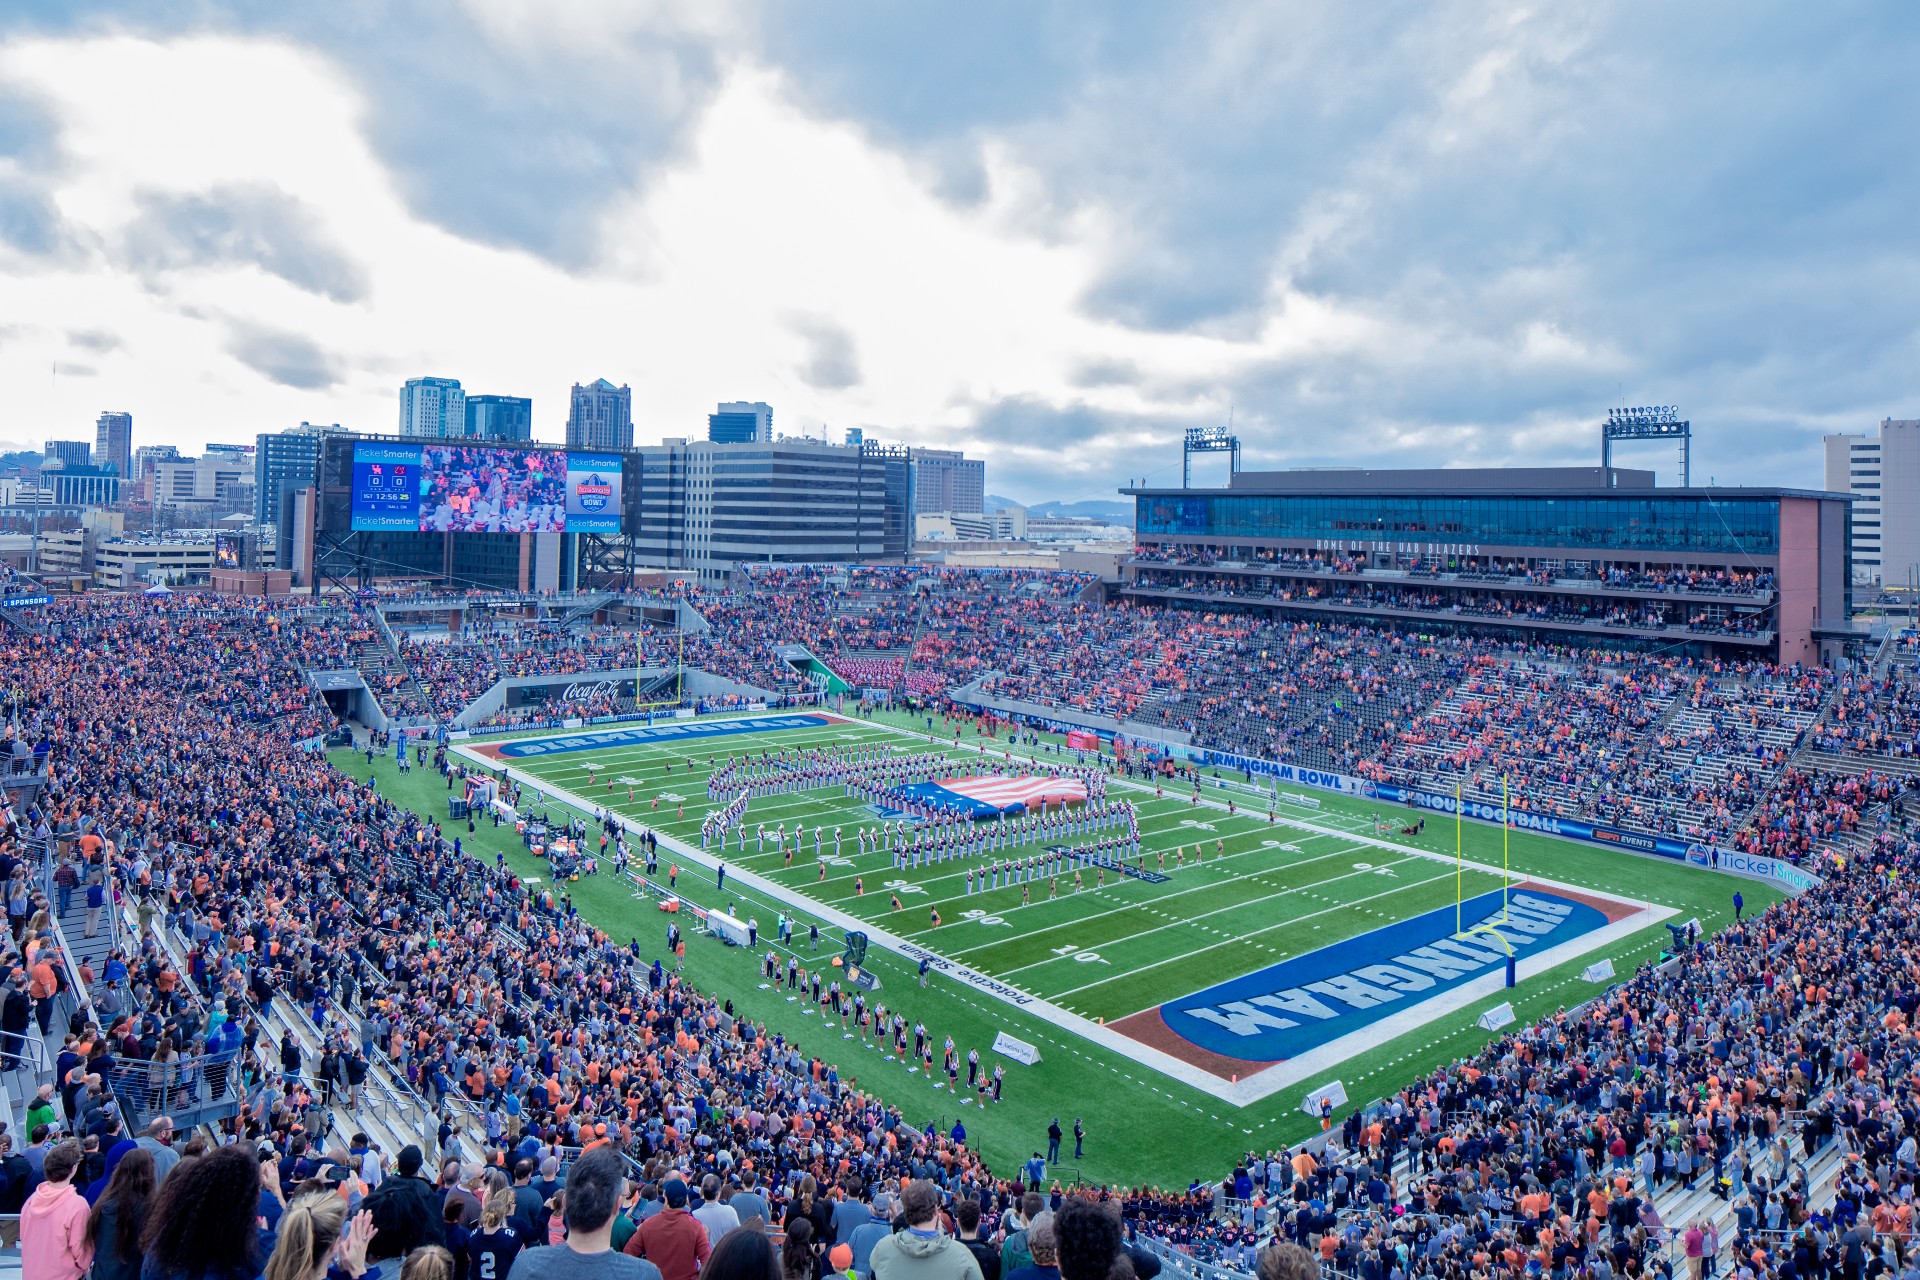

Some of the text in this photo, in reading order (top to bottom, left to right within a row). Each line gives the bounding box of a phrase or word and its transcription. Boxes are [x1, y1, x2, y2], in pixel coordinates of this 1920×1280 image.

[358, 448, 417, 459] TicketSmarter
[571, 459, 619, 467] TicketSmarter
[355, 516, 415, 525] TicketSmarter
[569, 519, 616, 528] TicketSmarter
[1316, 539, 1479, 555] HOME OF THE UAB BLAZERS
[10, 597, 48, 606] SPONSORS
[508, 721, 549, 731] HOSPITALIT
[515, 718, 817, 754] BIRMINGHAM
[1203, 750, 1342, 789] BRMINGHAM BOWL
[1398, 789, 1561, 834] SRIOUS FOOTBALL
[1596, 830, 1653, 848] ESPN EVENTS
[1188, 894, 1574, 1036] BIRMINGHAM
[898, 944, 1034, 1005] Protective Stadium
[504, 1228, 515, 1238] 2
[480, 1251, 497, 1280] 2
